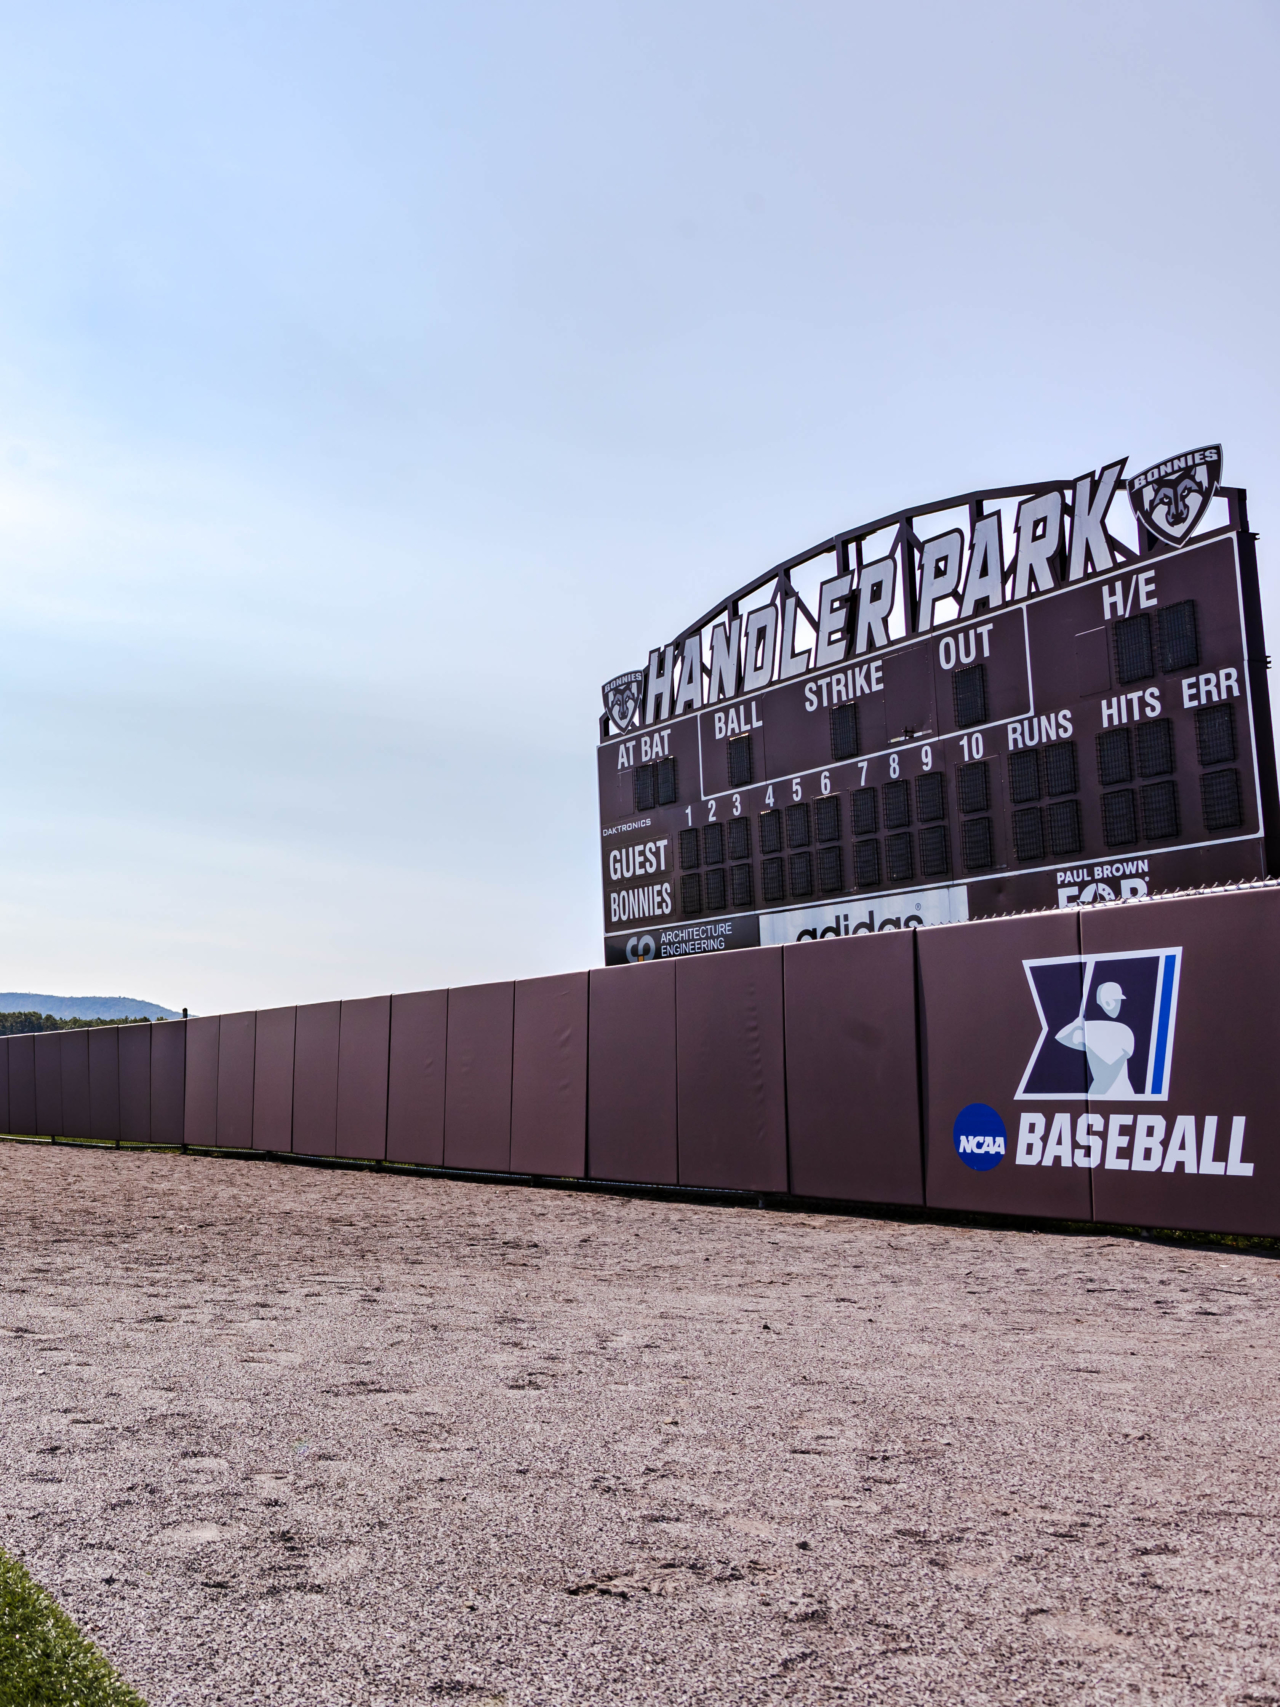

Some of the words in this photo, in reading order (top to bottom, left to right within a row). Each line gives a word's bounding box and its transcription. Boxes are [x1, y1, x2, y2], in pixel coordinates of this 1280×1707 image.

[1133, 448, 1219, 491] BONNIES
[643, 554, 897, 725] HANDLER
[918, 461, 1125, 633] PARK
[1102, 569, 1158, 621] H/E
[938, 623, 993, 670] OUT
[604, 672, 642, 692] BONNIES
[804, 659, 884, 712] STRIKE
[1181, 667, 1240, 709] ERR
[714, 701, 763, 740] BALL
[1101, 686, 1162, 728] HITS
[617, 740, 636, 770] AT
[641, 729, 671, 762] BAT
[1007, 709, 1073, 751] RUNS
[685, 805, 692, 826] 1
[708, 800, 716, 822] 2
[732, 794, 741, 816] 3
[765, 785, 775, 807] 4
[792, 778, 802, 801] 5
[820, 771, 831, 794] 6
[857, 761, 868, 786] 7
[889, 754, 900, 779] 8
[921, 745, 932, 771] 9
[959, 733, 984, 762] 10
[603, 818, 651, 837] DAKTRONICS
[609, 839, 668, 881] GUEST
[1056, 868, 1091, 885] PAUL
[1094, 859, 1149, 880] BROWN
[611, 882, 671, 922] BONNIES
[660, 922, 733, 944] ARCHITECTURE
[661, 938, 725, 957] ENGINEERING
[959, 1135, 1006, 1155] NCAA
[1015, 1112, 1255, 1177] BASEBALL
